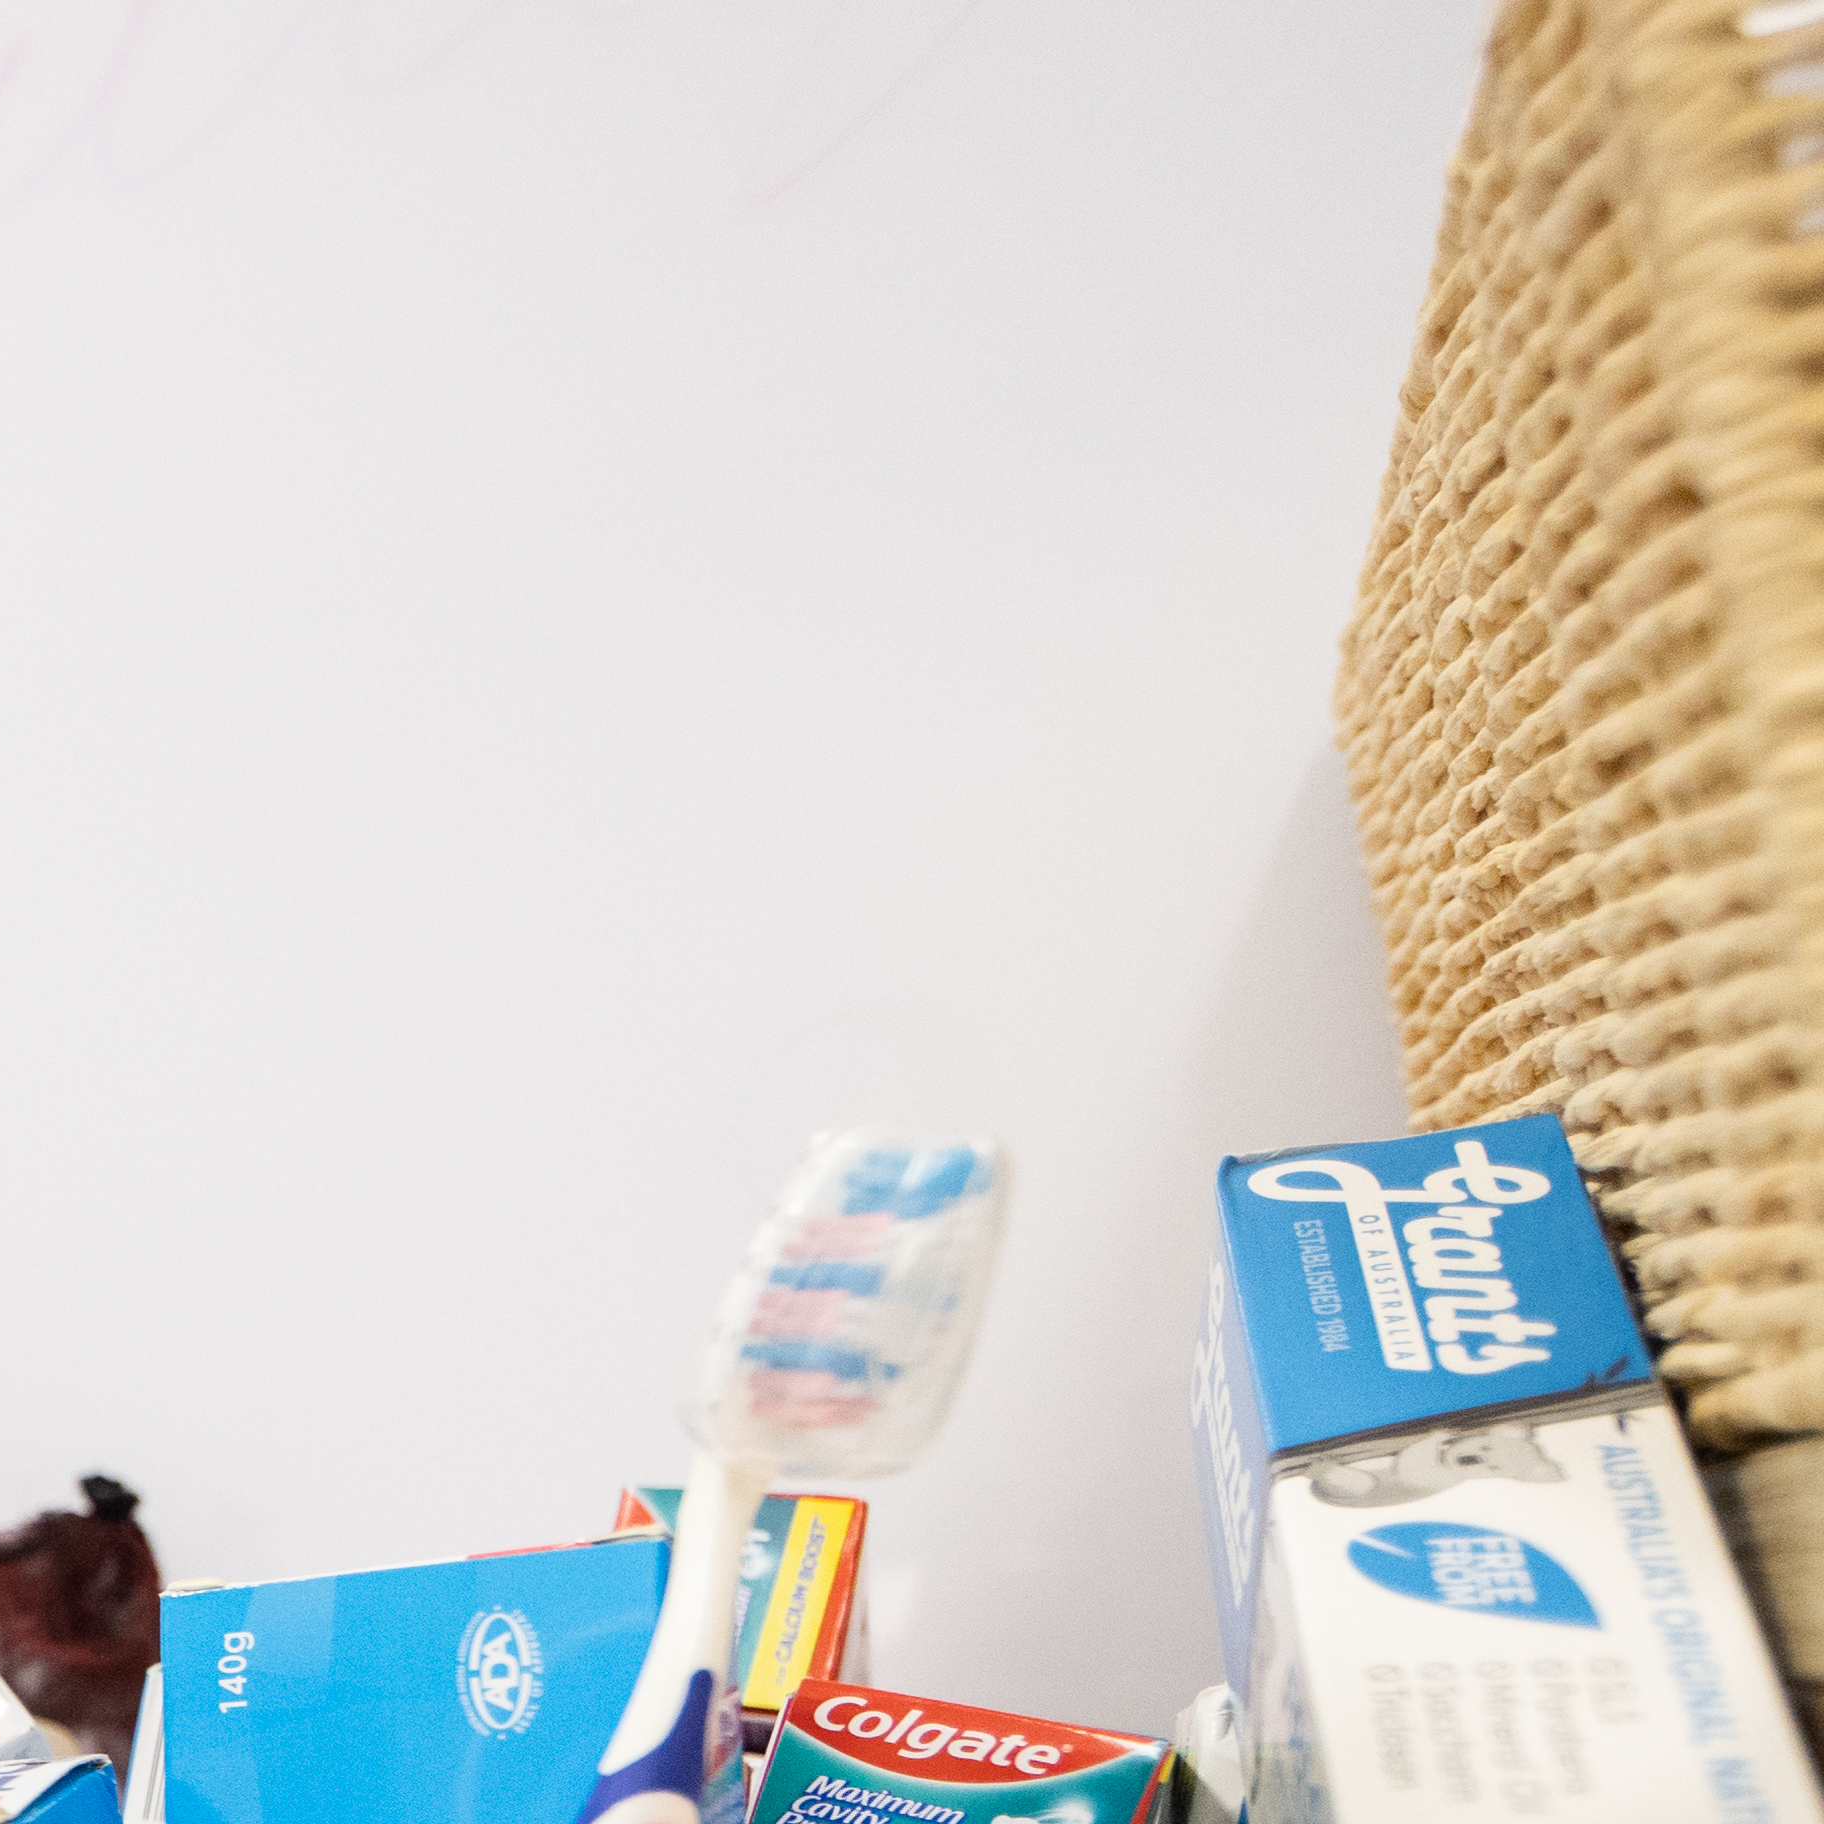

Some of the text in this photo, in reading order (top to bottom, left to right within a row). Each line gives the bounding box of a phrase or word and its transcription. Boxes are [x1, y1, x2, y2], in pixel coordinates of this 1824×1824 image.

[1293, 1219, 1351, 1353] ESTABLISHED 1984
[1358, 1214, 1417, 1362] OF AUSTRALIA
[1424, 1538, 1488, 1607] FROM
[1472, 1536, 1539, 1604] FREE
[218, 1630, 255, 1713] 140g
[480, 1631, 519, 1712] ADA
[812, 1694, 1062, 1777] Colgate
